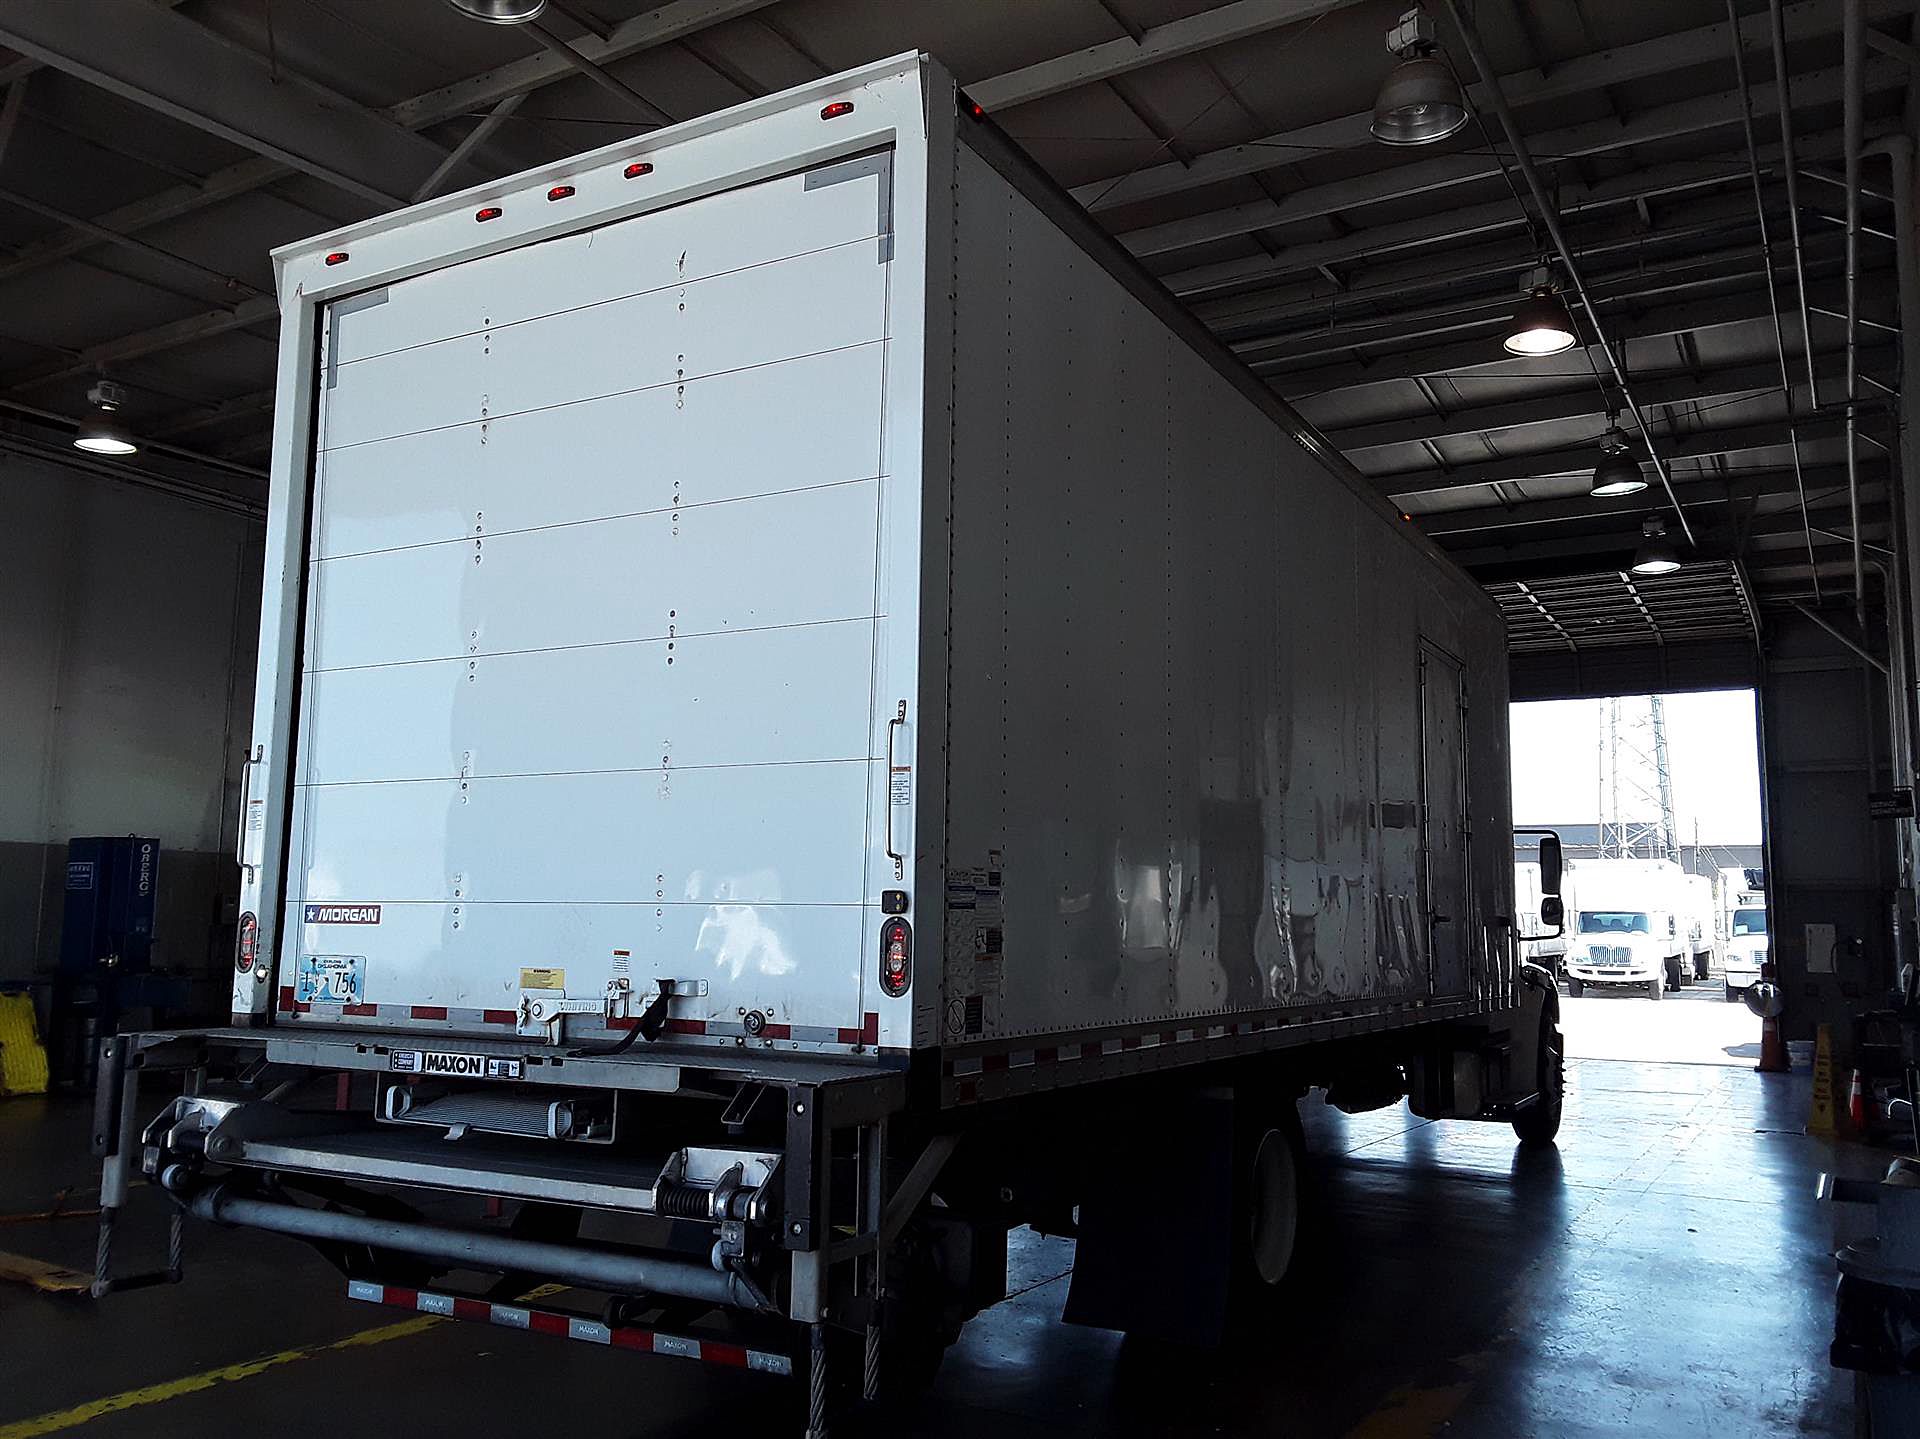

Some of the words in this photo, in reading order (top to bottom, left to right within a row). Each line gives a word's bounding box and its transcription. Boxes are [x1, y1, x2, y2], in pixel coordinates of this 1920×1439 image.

[318, 908, 378, 922] MORGAN
[335, 972, 356, 994] 756
[426, 1054, 481, 1074] MAXON
